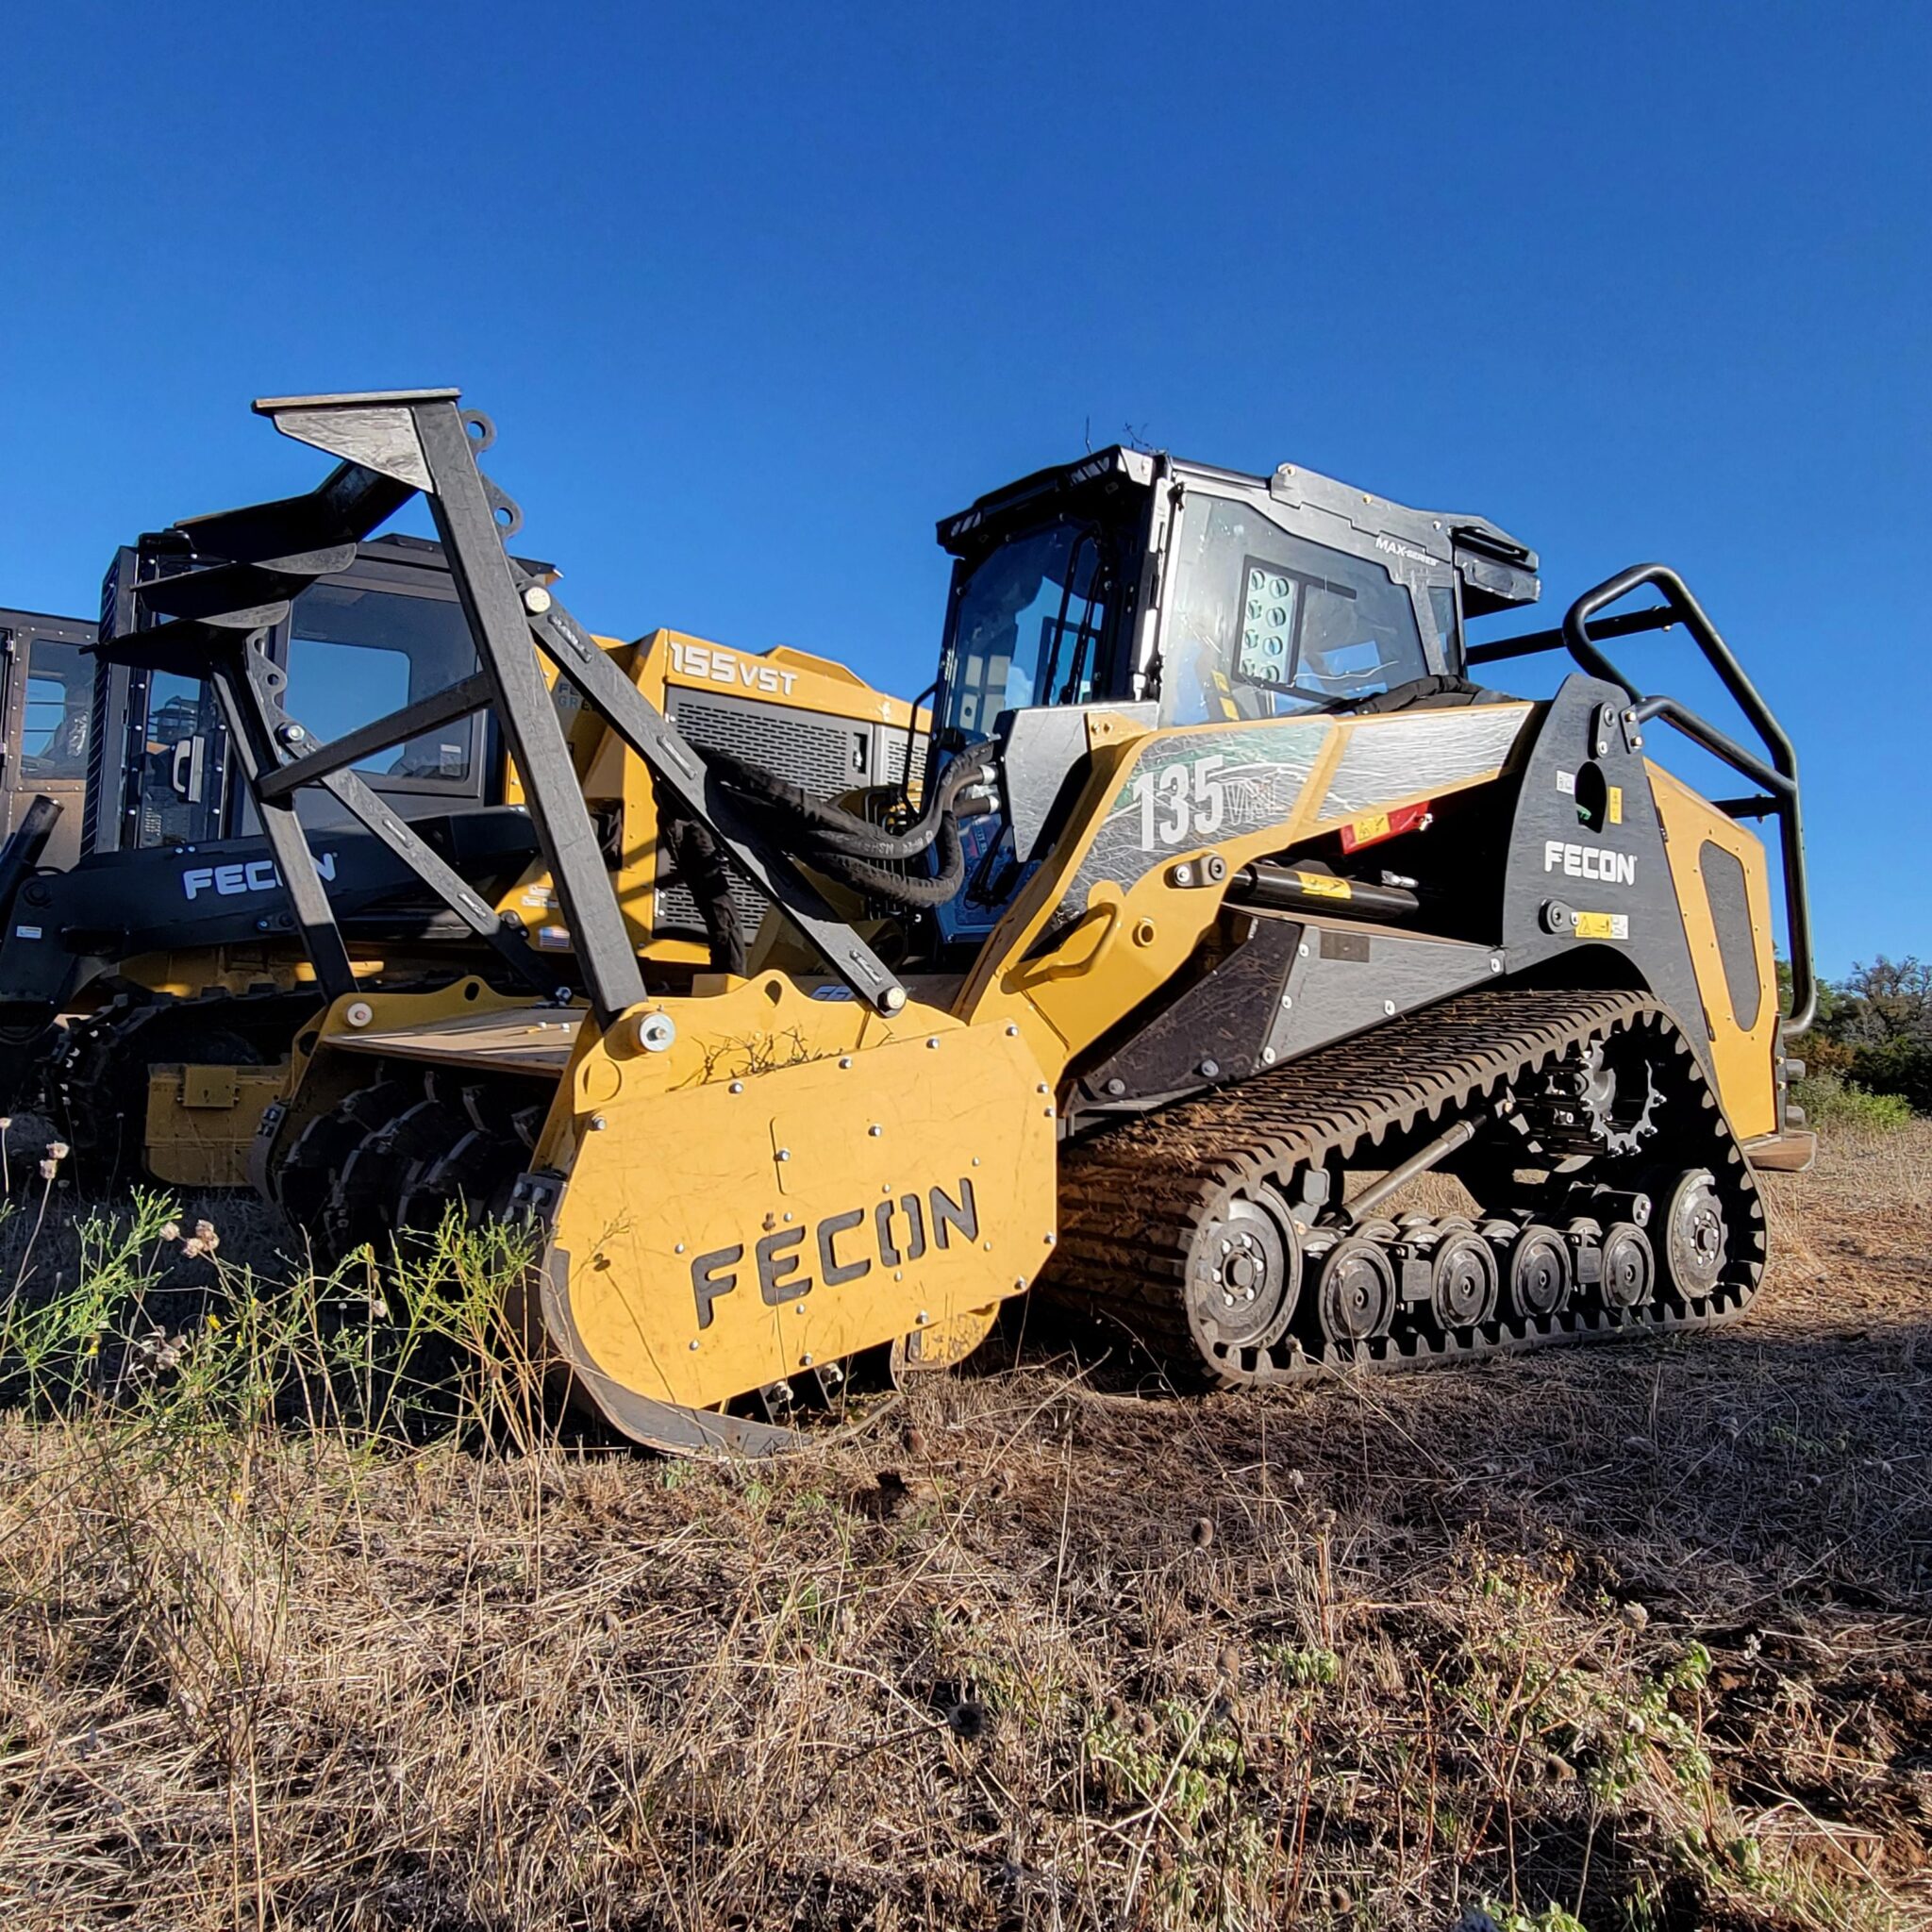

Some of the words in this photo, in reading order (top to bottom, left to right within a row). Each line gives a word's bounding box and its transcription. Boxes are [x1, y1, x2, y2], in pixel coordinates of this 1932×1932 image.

[1131, 754, 1224, 851] 135
[182, 852, 337, 900] FECN
[1544, 840, 1635, 886] FECON
[690, 1176, 979, 1331] FECON
